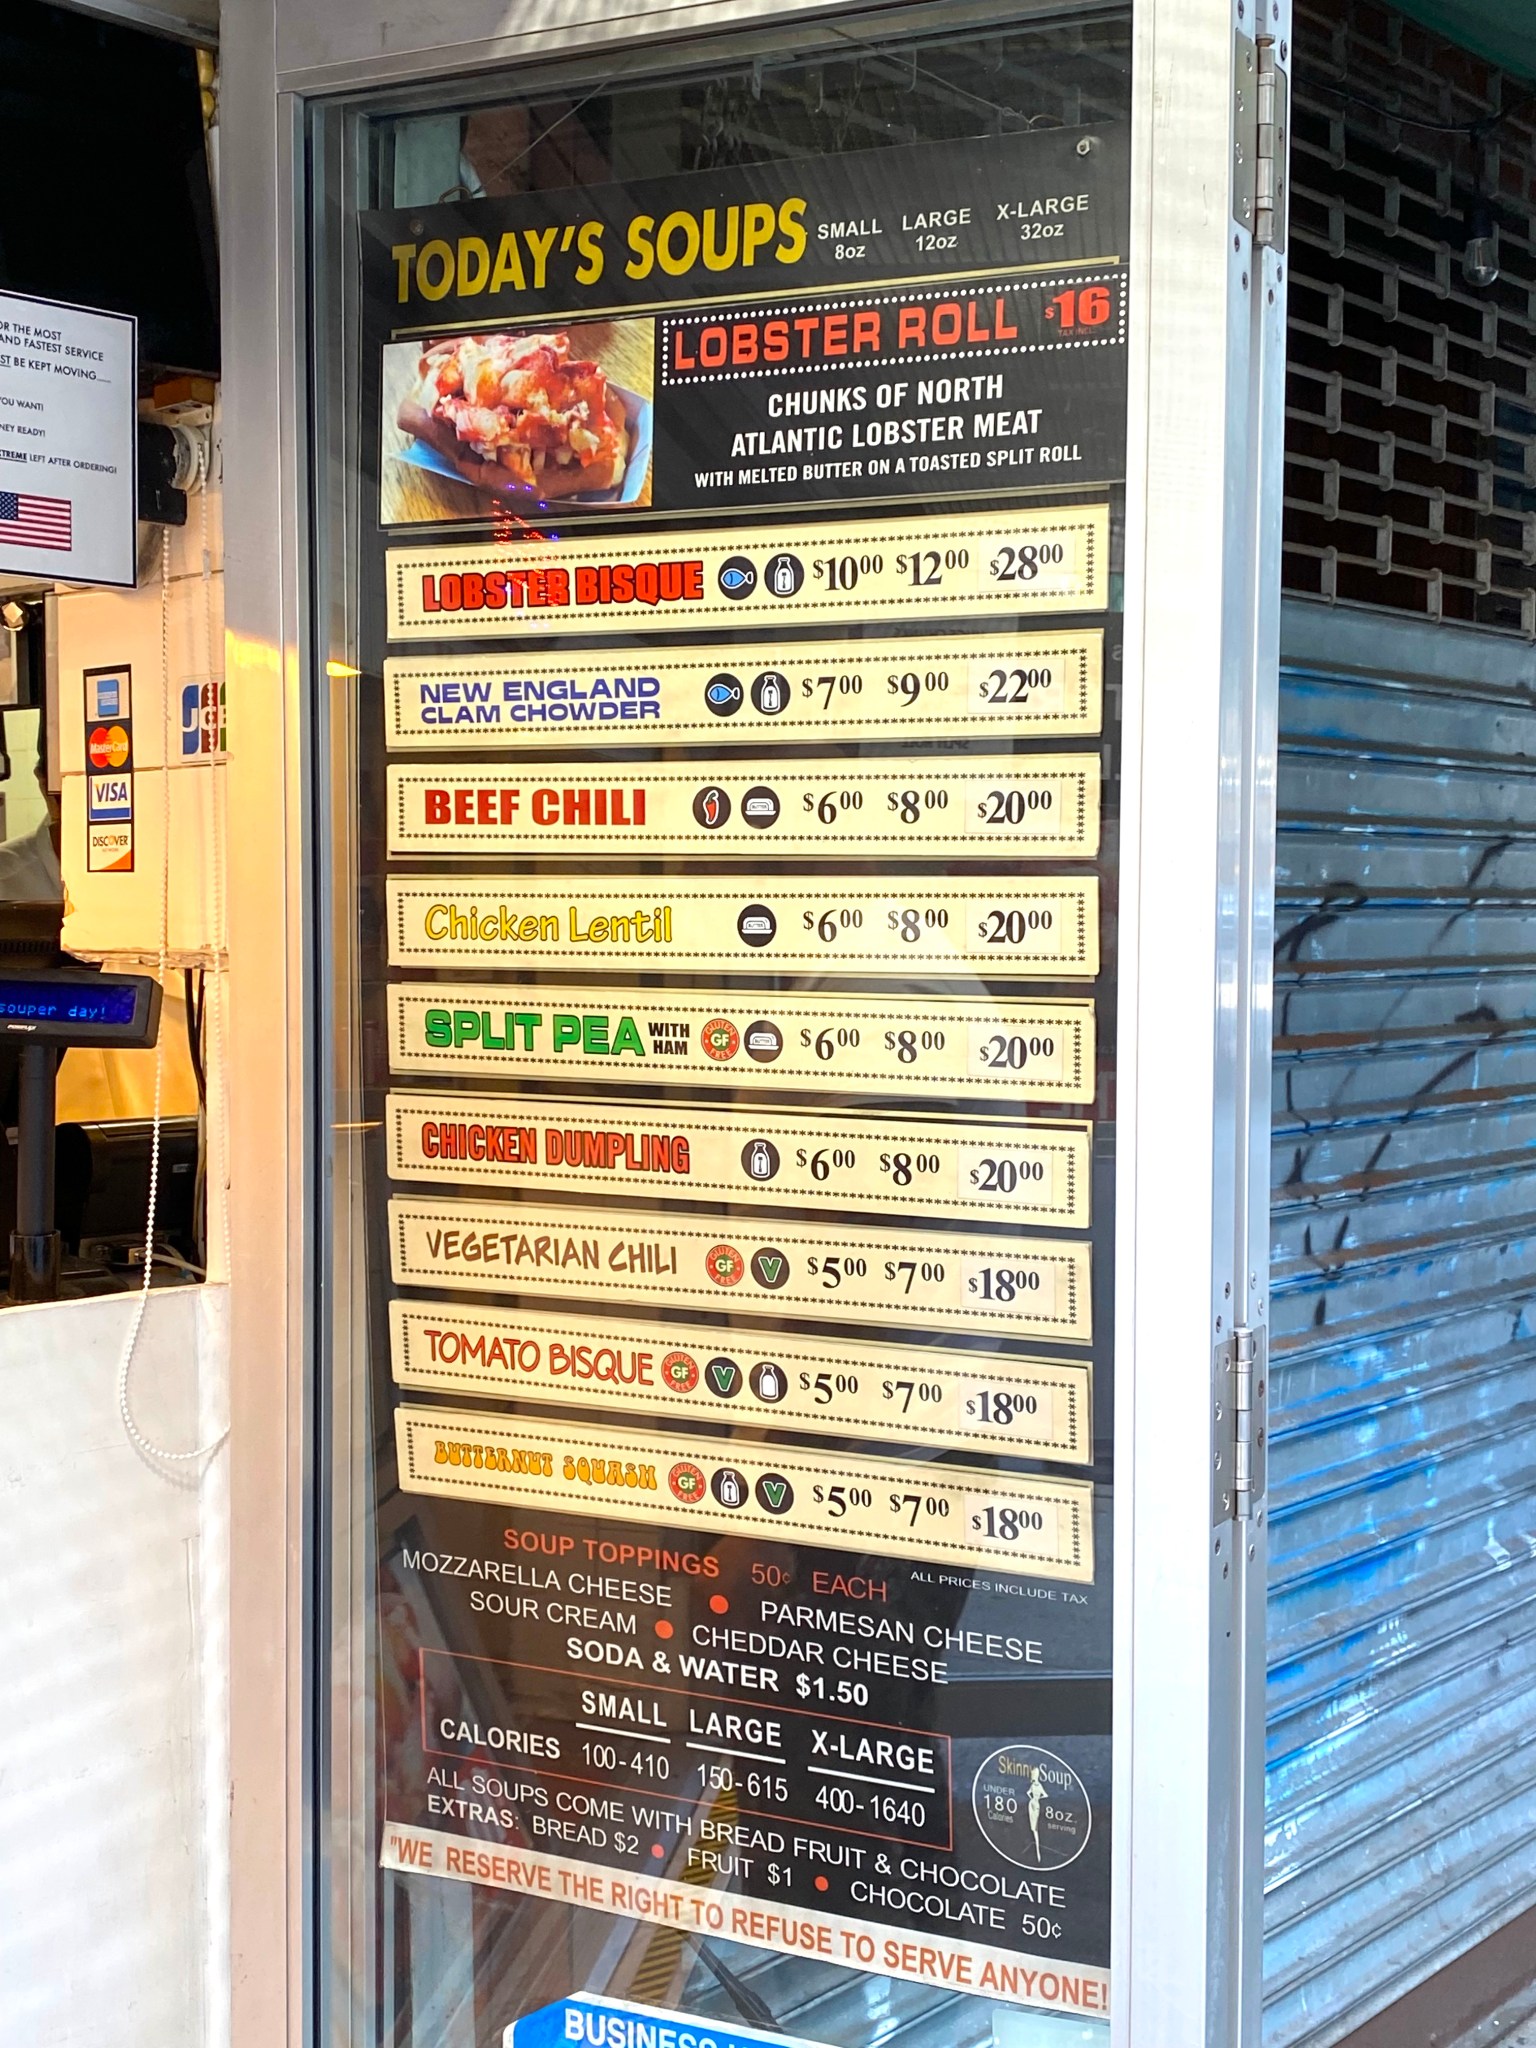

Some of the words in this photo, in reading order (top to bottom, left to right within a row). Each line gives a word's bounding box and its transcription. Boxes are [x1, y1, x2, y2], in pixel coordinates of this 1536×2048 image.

[817, 218, 883, 239] SMALL
[902, 208, 971, 231] LARGE
[997, 195, 1089, 220] X-LARGE
[392, 222, 604, 303] TODAY'S
[625, 197, 808, 280] SOUPS
[834, 243, 865, 259] 8oz
[916, 234, 958, 252] 12oz
[1021, 223, 1064, 240] 32oz
[13, 324, 31, 335] THE
[34, 328, 61, 341] MOST
[24, 338, 62, 353] FASTEST
[65, 346, 103, 361] SERVICE
[674, 311, 880, 370] LOBSTER
[899, 299, 1018, 349] ROLL
[14, 357, 25, 367] BE
[28, 359, 51, 372] KEPT
[768, 386, 866, 418] CHUNKS
[876, 382, 908, 407] OF
[917, 374, 1003, 405] NORTH
[730, 424, 842, 458] ATLANTIC
[853, 416, 963, 448] LOBSTER
[974, 409, 1042, 439] MEAT
[30, 454, 45, 463] LEFT
[48, 457, 71, 468] AFTER
[694, 470, 734, 488] WITH
[738, 464, 797, 486] MELTED
[803, 460, 862, 481] BUTTER
[868, 459, 890, 475] ON
[895, 457, 905, 473] A
[910, 451, 981, 472] TOASTED
[987, 447, 1034, 467] SPLIT
[1040, 444, 1082, 463] ROLL
[422, 568, 570, 612] LOBSTER
[576, 560, 703, 606] BISQUE
[421, 682, 492, 703] NEW
[503, 677, 660, 701] ENGLAND
[421, 704, 500, 724] CLAM
[510, 701, 660, 722] CHOWDER
[90, 742, 128, 753] MasterCard
[95, 782, 127, 802] VISA
[424, 789, 520, 825] BEEF
[532, 789, 646, 826] CHILI
[93, 836, 128, 846] DISCOVER
[425, 904, 559, 941] Chicken
[569, 906, 672, 943] Lentil
[0, 1004, 56, 1016] souper
[68, 1006, 105, 1019] day!
[648, 1022, 690, 1038] WITH
[706, 1021, 735, 1036] GLUTEN
[425, 1009, 542, 1051] SPLIT
[553, 1014, 646, 1056] PEA
[653, 1040, 688, 1056] HAM
[711, 1033, 729, 1046] GF
[422, 1122, 537, 1164] CHICKEN
[545, 1128, 690, 1174] DUMPLING
[426, 1229, 599, 1270] VEGETARIAN
[608, 1242, 677, 1275] CHILI
[424, 1330, 541, 1372] TOMATO
[549, 1343, 654, 1386] BISQUE
[434, 1440, 552, 1477] BUTTERNUT
[563, 1456, 658, 1491] SQUASH
[503, 1528, 575, 1555] SOUP
[583, 1539, 719, 1578] TOPPINGS
[812, 1571, 887, 1602] EACH
[402, 1549, 561, 1591] MOZZARELLA
[568, 1573, 672, 1607] CHEESE
[761, 1601, 914, 1644] PARMESAN
[923, 1626, 1043, 1664] CHEESE
[911, 1571, 935, 1583] ALL
[939, 1574, 991, 1592] PRICES
[995, 1583, 1057, 1601] INCLUDE
[1062, 1592, 1088, 1605] TAX
[470, 1591, 539, 1619] SOUR
[547, 1603, 637, 1634] CREAM
[692, 1625, 824, 1665] CHEDDAR
[833, 1647, 948, 1684] CHEESE
[567, 1638, 644, 1670] SODA
[652, 1651, 671, 1673] &
[679, 1654, 779, 1692] WATER
[796, 1672, 868, 1706] $1.50
[440, 1718, 560, 1759] CALORIES
[581, 1690, 667, 1727] SMALL
[689, 1708, 782, 1748] LARGE
[812, 1729, 934, 1774] X-LARGE
[983, 1784, 1015, 1796] UNDER
[1040, 1763, 1071, 1790] Soup
[984, 1794, 1017, 1814] 180
[988, 1810, 1013, 1823] Calories
[427, 1767, 464, 1790] ALL
[472, 1775, 548, 1807] SOUPS
[556, 1791, 623, 1822] COME
[631, 1806, 692, 1835] WITH
[700, 1820, 784, 1853] BREAD
[793, 1837, 866, 1869] FRUIT
[874, 1853, 892, 1875] &
[900, 1859, 1066, 1909] CHOCOLATE
[1048, 1823, 1076, 1835] serving
[428, 1794, 519, 1829] EXTRAS:
[532, 1815, 607, 1847] BREAD
[615, 1832, 639, 1855] $2
[687, 1847, 754, 1880] FRUIT
[768, 1862, 791, 1887] $1
[851, 1881, 1006, 1930] CHOCOLATE
[390, 1836, 432, 1868] "WE
[446, 1846, 551, 1892] RESERVE
[558, 1870, 603, 1904] THE
[611, 1882, 683, 1921] RIGHT
[691, 1901, 724, 1930] TO
[732, 1909, 832, 1955] REFUSE
[840, 1931, 875, 1963] TO
[883, 1940, 972, 1985] SERVE
[980, 1961, 1108, 2010] ANYONE!
